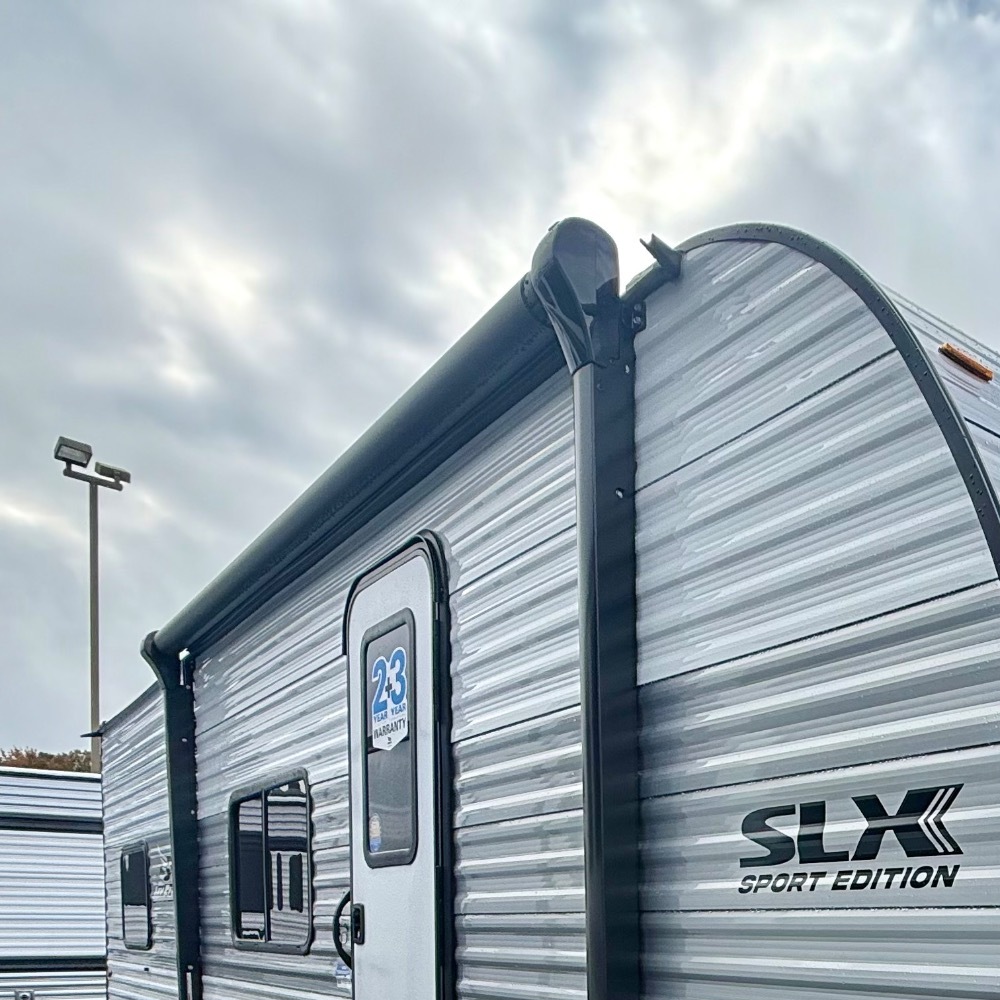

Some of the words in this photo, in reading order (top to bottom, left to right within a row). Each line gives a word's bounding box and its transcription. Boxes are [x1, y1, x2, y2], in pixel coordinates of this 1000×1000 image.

[373, 710, 388, 723] YEAR
[391, 702, 407, 716] YEAR
[373, 717, 407, 740] WARRANTY
[739, 783, 964, 868] SLX
[738, 871, 828, 894] SPORT
[831, 864, 961, 891] EDITION
